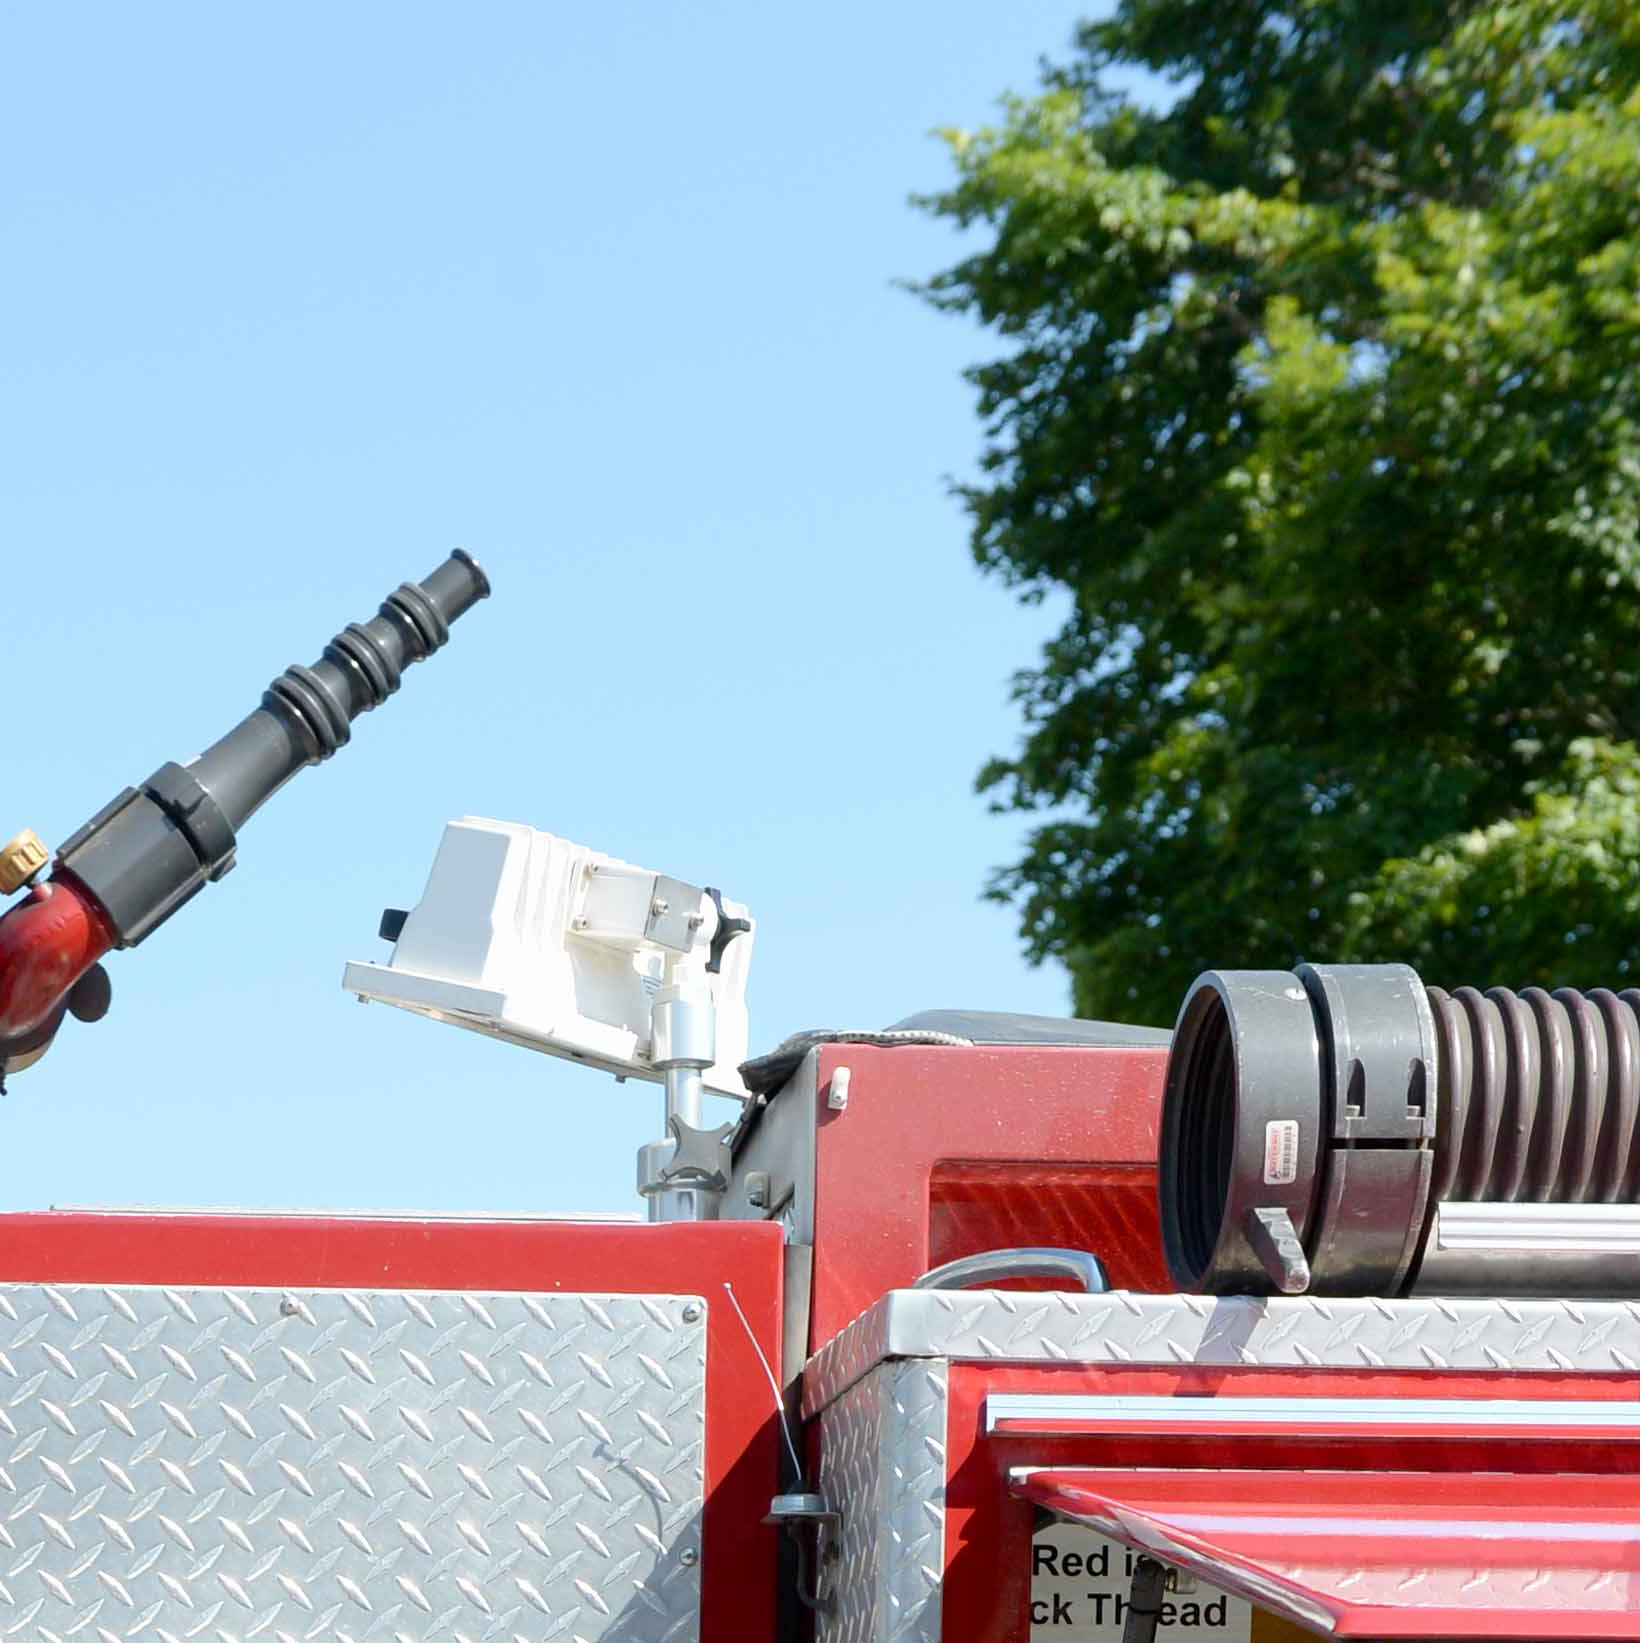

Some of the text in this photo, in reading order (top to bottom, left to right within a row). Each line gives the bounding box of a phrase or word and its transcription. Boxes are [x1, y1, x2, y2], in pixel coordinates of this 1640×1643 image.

[1033, 1544, 1108, 1576] Red
[1031, 1593, 1226, 1626] ck Thead
